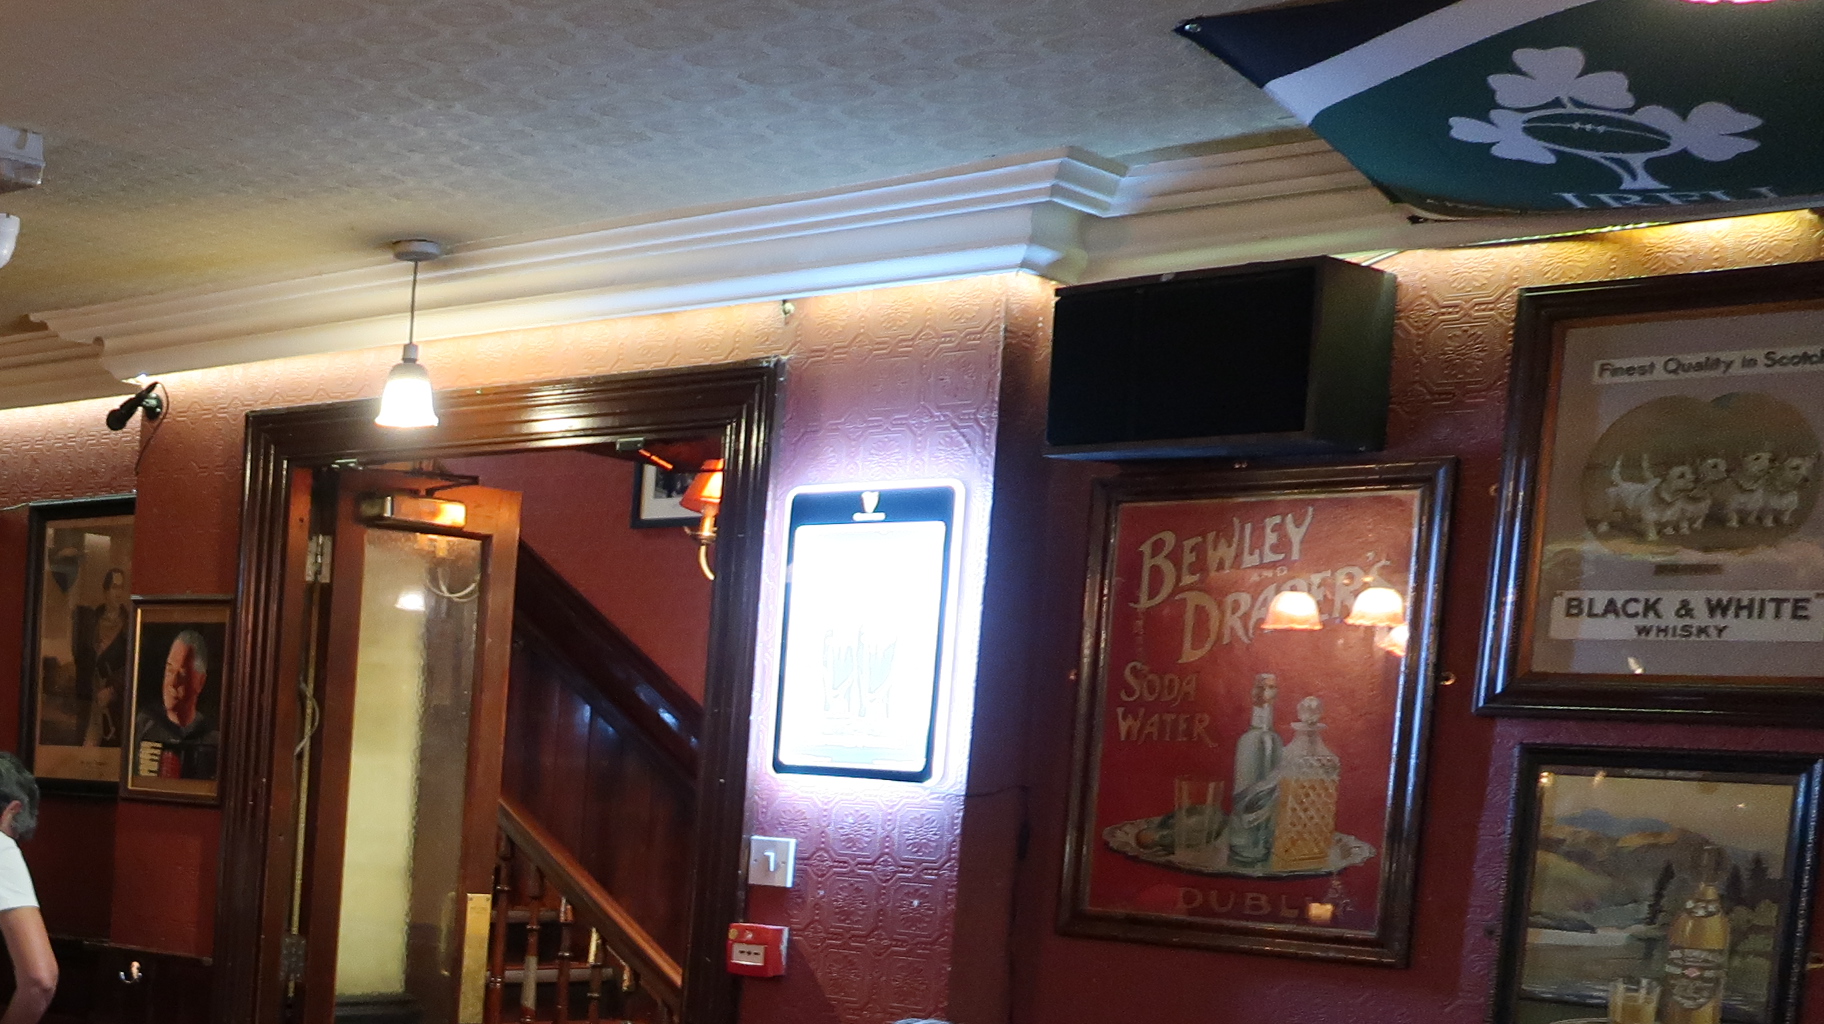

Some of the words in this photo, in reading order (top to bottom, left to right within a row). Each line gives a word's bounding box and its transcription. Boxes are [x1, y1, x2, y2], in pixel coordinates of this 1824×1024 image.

[1597, 361, 1655, 378] Finest
[1662, 356, 1734, 375] Quality
[1129, 506, 1314, 609] BEWLEY
[1674, 597, 1696, 619] &
[1705, 596, 1814, 621] WHITE
[1634, 624, 1730, 640] WHISKY
[1119, 660, 1201, 708] SODA
[1115, 706, 1220, 749] WATER
